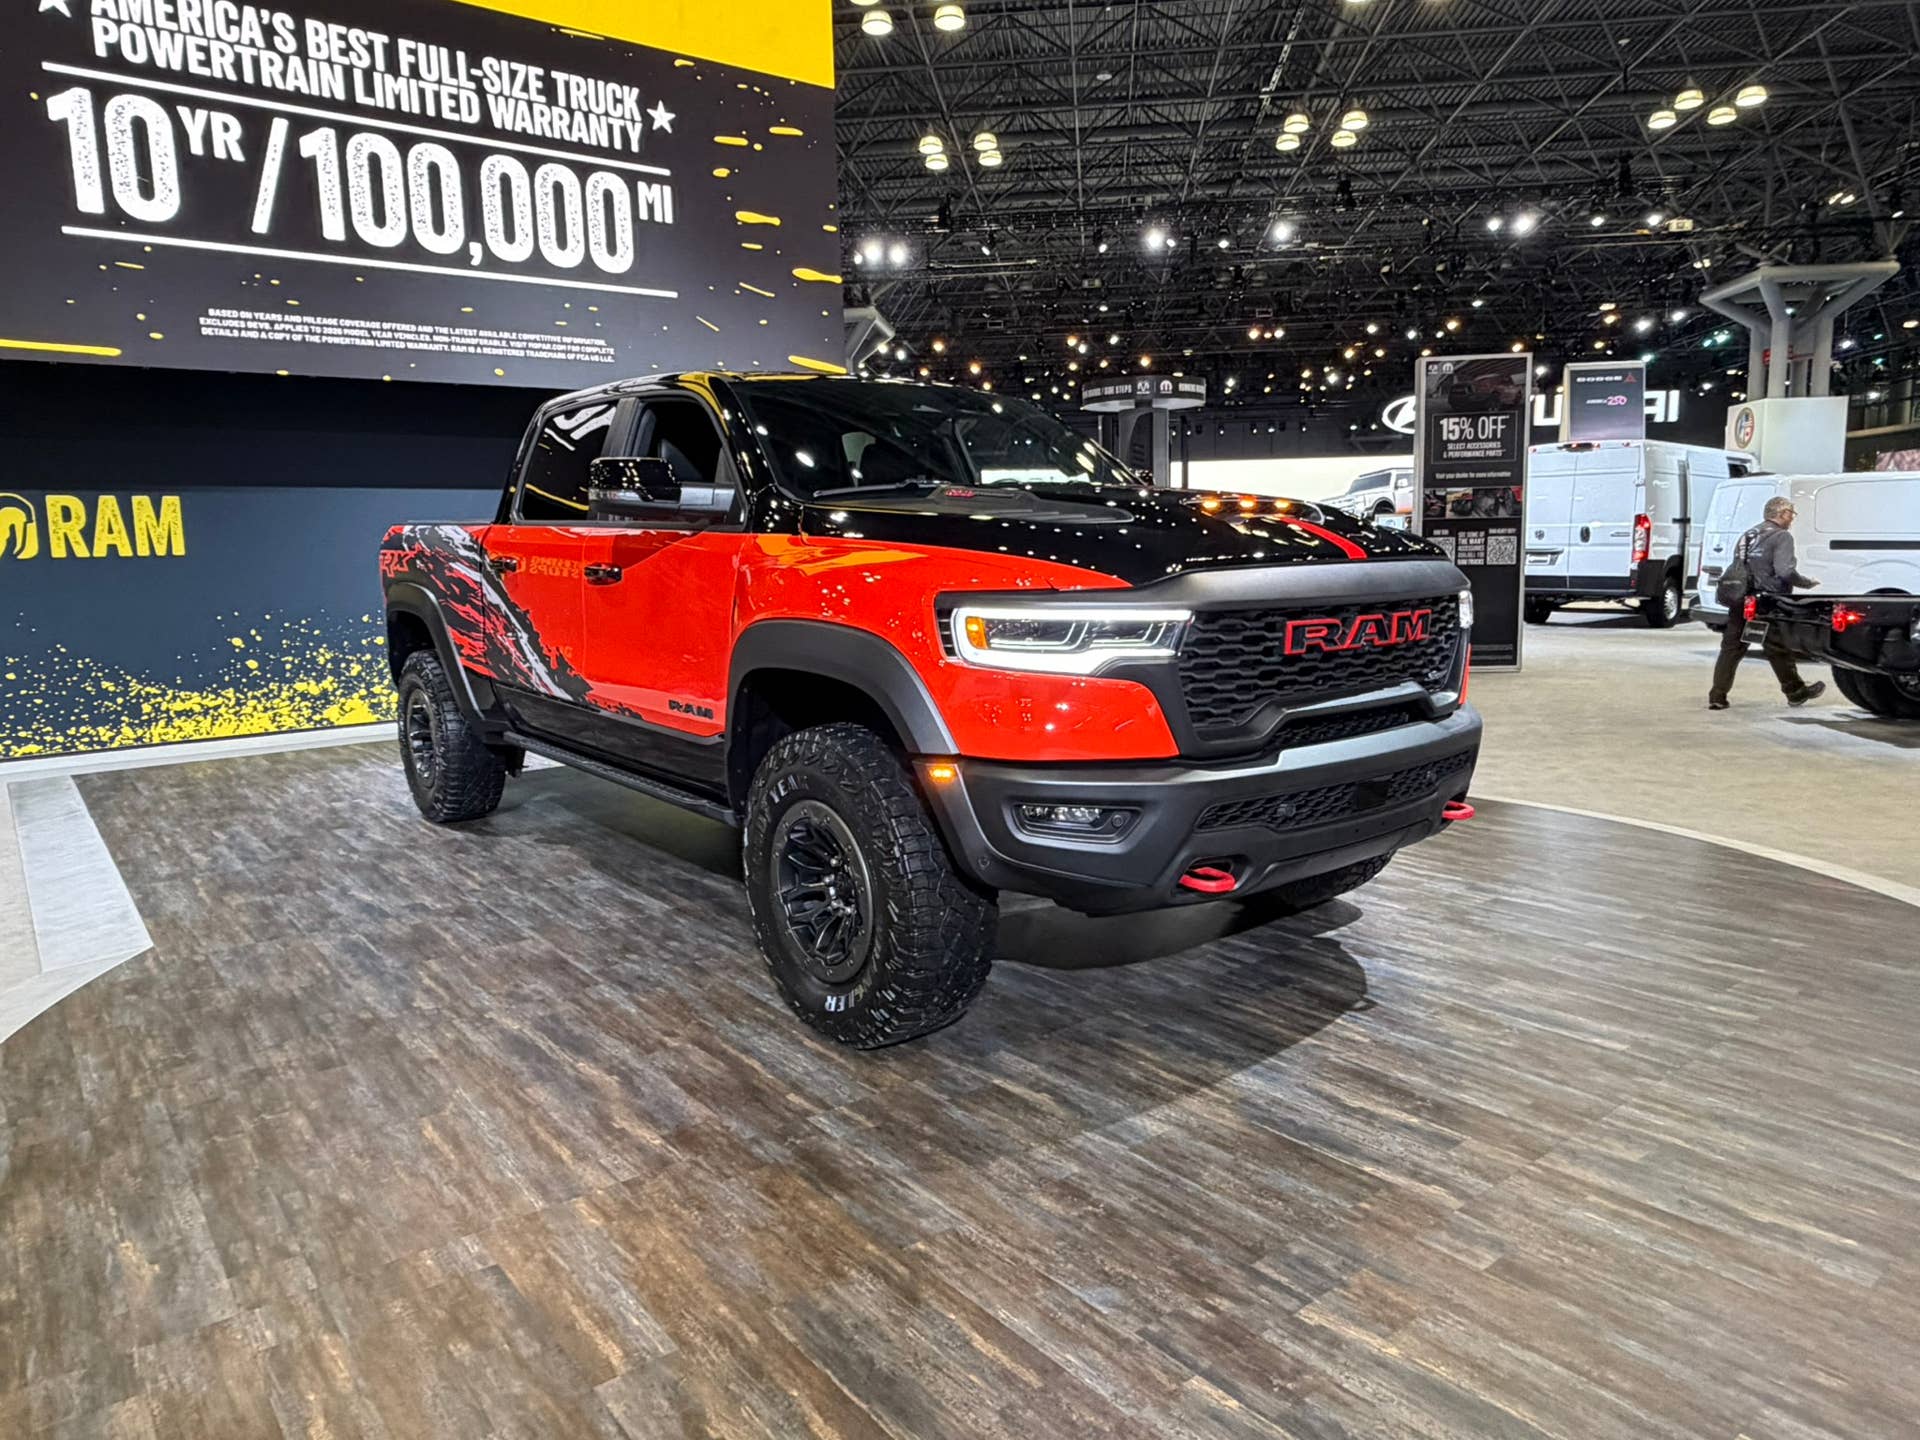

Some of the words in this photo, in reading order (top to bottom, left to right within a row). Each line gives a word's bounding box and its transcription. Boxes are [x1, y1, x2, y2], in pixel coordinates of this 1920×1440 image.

[91, 16, 346, 101] POWERTRAIN
[353, 68, 480, 124] LIMITED
[486, 93, 643, 153] WARRANTY
[304, 18, 389, 72] BEST
[397, 38, 547, 103] FULL-SIZE
[551, 70, 642, 122] TRUCK
[46, 87, 181, 222] 10
[175, 105, 246, 162] YR
[251, 117, 289, 234] /
[299, 126, 635, 274] 100,000
[637, 181, 674, 224] MI
[199, 317, 245, 328] EXCLUDES
[273, 322, 308, 333] APPLIES
[310, 325, 321, 334] TO
[343, 328, 369, 338] MODEL
[372, 330, 392, 339] YEAR
[510, 340, 527, 349] VISIT
[528, 342, 566, 352] MOPAR.COM
[567, 344, 579, 353] FOR
[581, 345, 614, 356] COMPLETE
[201, 326, 238, 338] DETAILS
[240, 329, 258, 339] AND
[260, 331, 267, 340] A
[268, 331, 290, 341] COPY
[291, 333, 302, 342] OF
[304, 334, 320, 343] THE
[322, 335, 373, 347] POWERTRAIN
[376, 339, 405, 349] LIMITED
[406, 341, 449, 352] WARRANTY.
[451, 344, 466, 353] RAM
[468, 345, 474, 354] IS
[476, 346, 481, 354] A
[483, 347, 524, 357] REGISTERED
[525, 350, 565, 360] TRADEMARK
[567, 353, 575, 361] OF
[576, 353, 589, 362] FCA
[208, 308, 237, 319] BASED
[239, 310, 252, 320] ON
[253, 311, 282, 322] YEARS
[284, 313, 301, 324] AND
[303, 315, 337, 326] MILEAGE
[339, 318, 380, 330] COVERAGE
[382, 322, 416, 332] OFFERED
[418, 325, 433, 334] AND
[434, 326, 448, 335] THE
[450, 327, 477, 337] LATEST
[478, 329, 516, 340] AVAILABLE
[518, 332, 560, 344] COMPETITIVE
[1440, 416, 1474, 440] 15%
[45, 495, 186, 558] RAM
[1284, 609, 1432, 654] RAM
[668, 699, 714, 720] RAM
